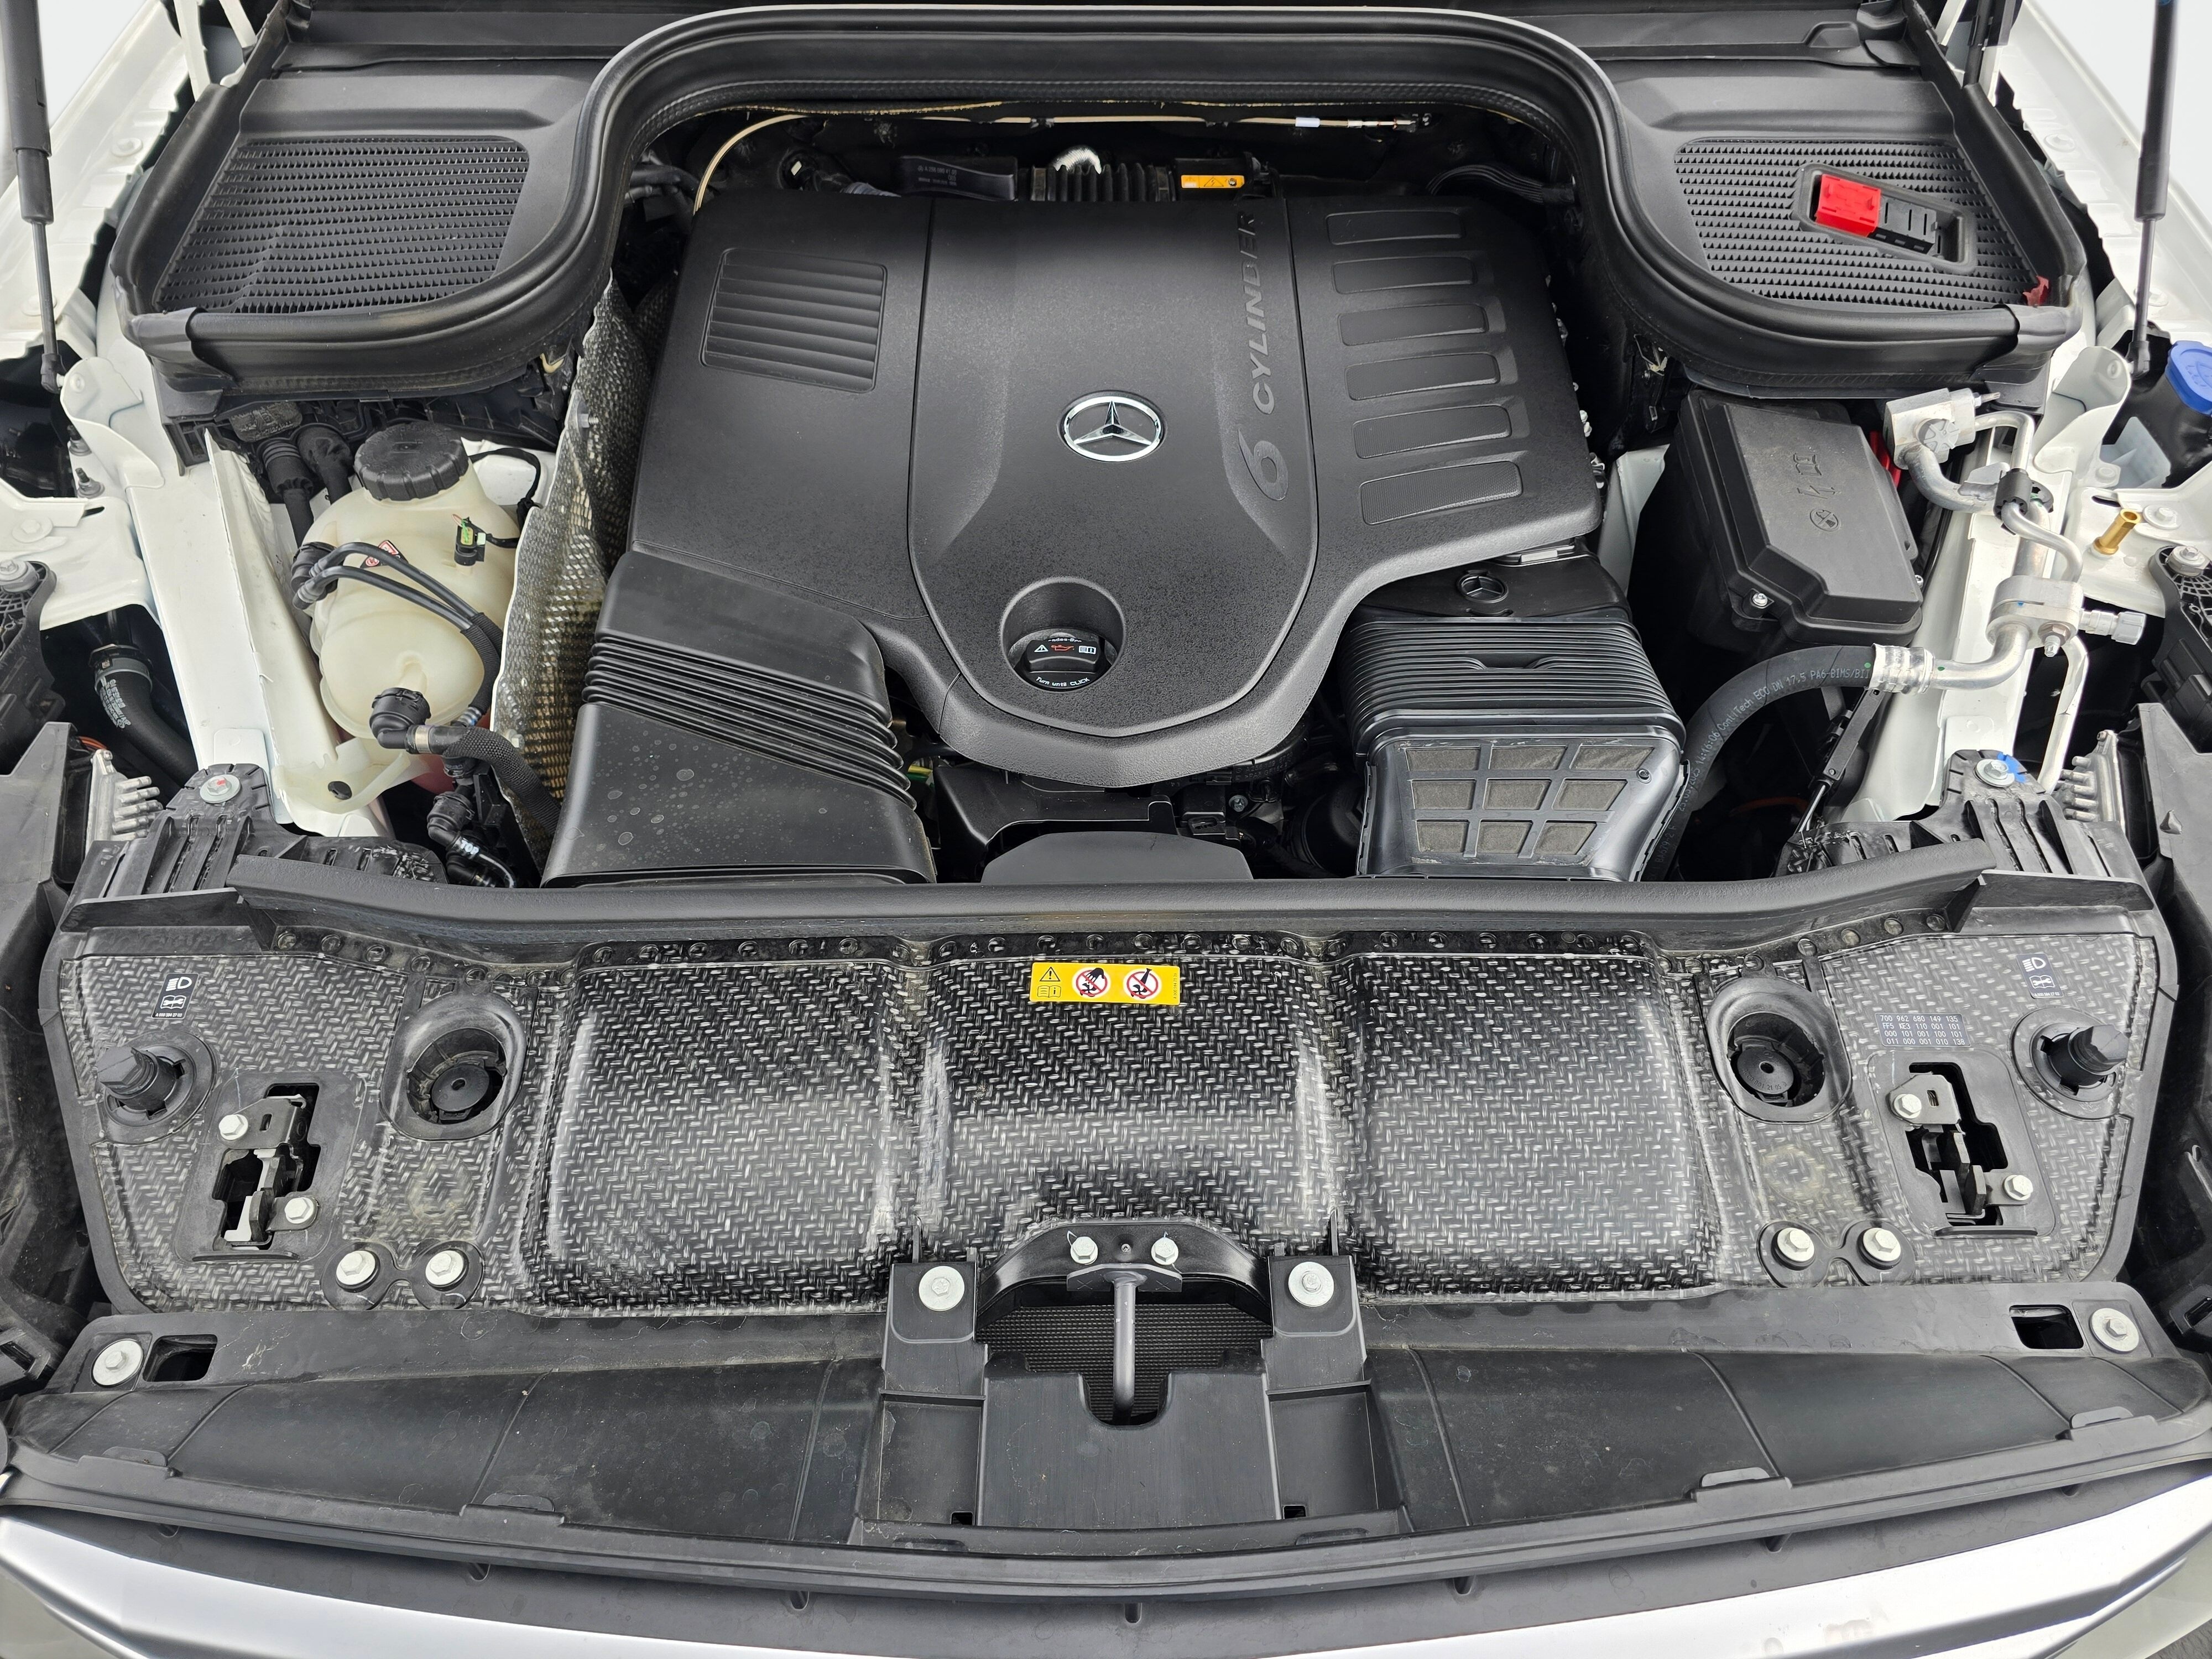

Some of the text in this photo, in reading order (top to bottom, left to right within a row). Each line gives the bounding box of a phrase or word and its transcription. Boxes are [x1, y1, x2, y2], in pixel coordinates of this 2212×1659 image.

[1237, 211, 1288, 501] 6 CYLINDER
[1036, 676, 1050, 685] Turn
[1070, 677, 1090, 686] CLICK
[1694, 731, 1720, 765] 14:16:06
[1717, 698, 1754, 731] ContiTech
[1753, 686, 1770, 701] ECO
[1771, 680, 1784, 692] DN
[460, 839, 479, 855] TOP
